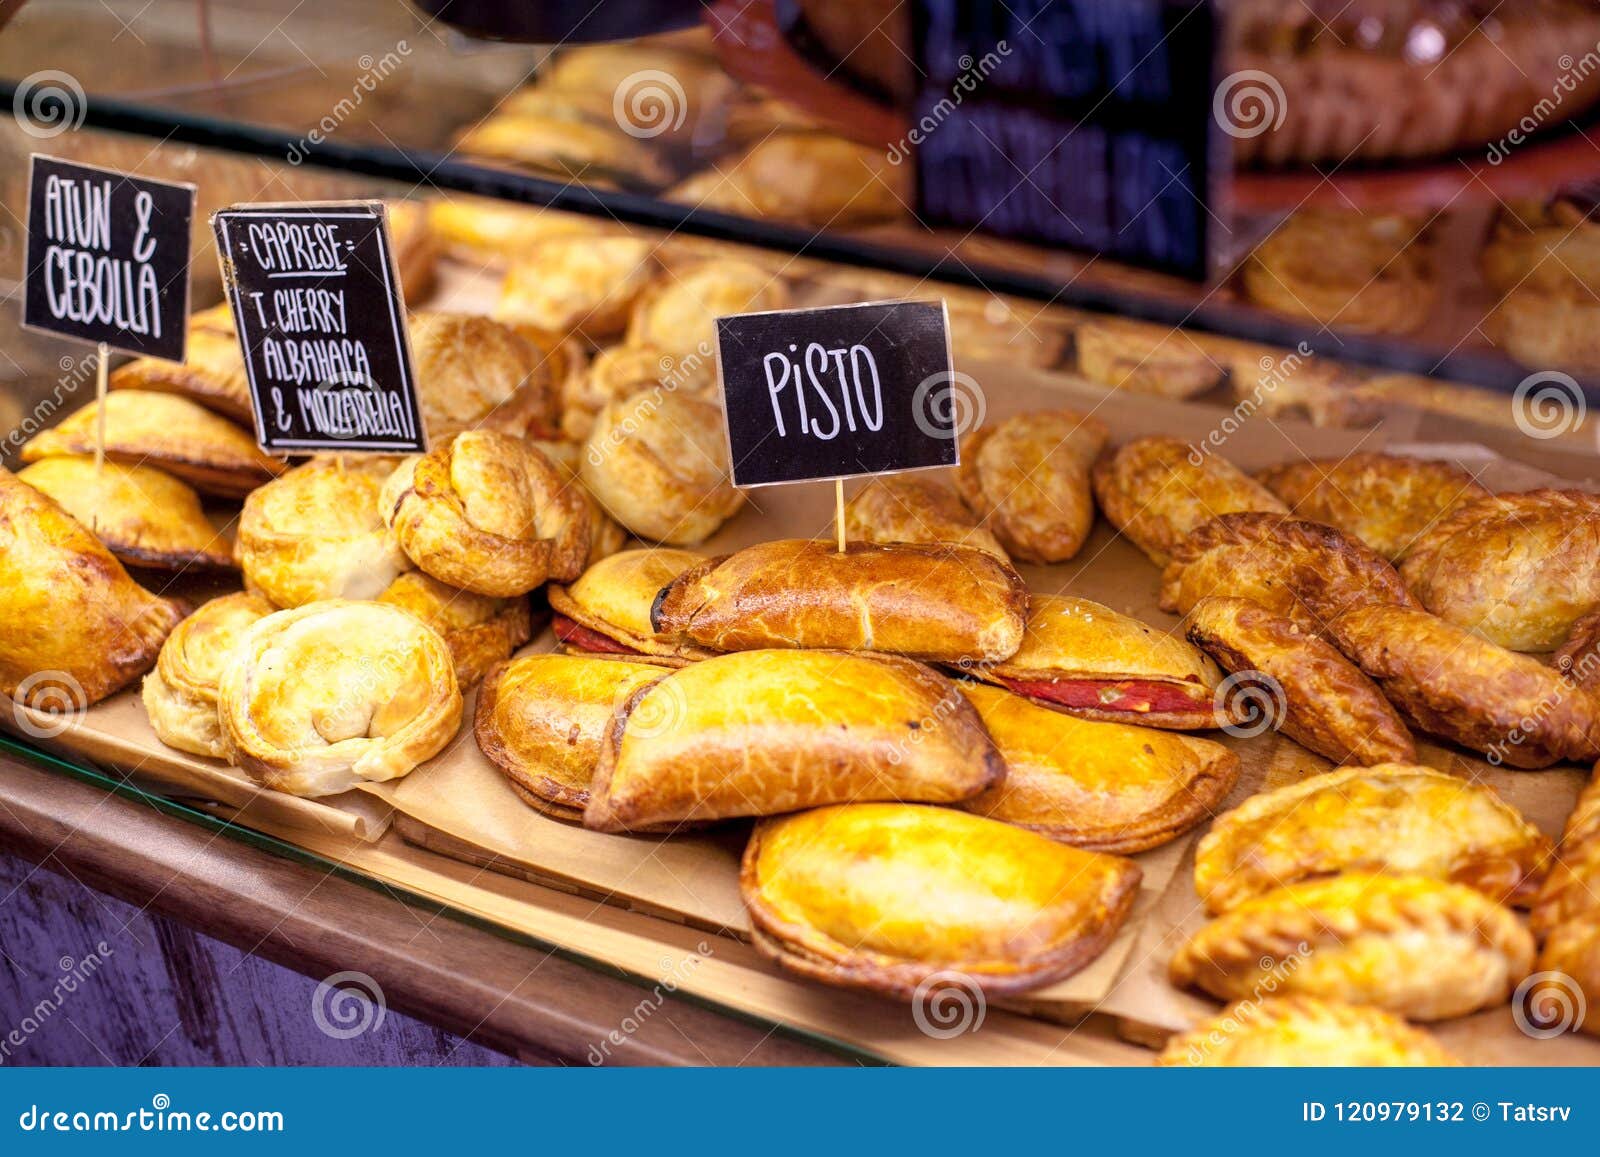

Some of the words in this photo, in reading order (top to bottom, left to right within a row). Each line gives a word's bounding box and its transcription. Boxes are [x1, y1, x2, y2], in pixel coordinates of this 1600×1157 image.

[45, 174, 111, 251] ATUN
[132, 190, 157, 263] &
[44, 245, 161, 339] CEBOLLA
[263, 337, 373, 388] ALBAHACA
[271, 386, 292, 432] &
[297, 387, 409, 440] MOZZARELLA
